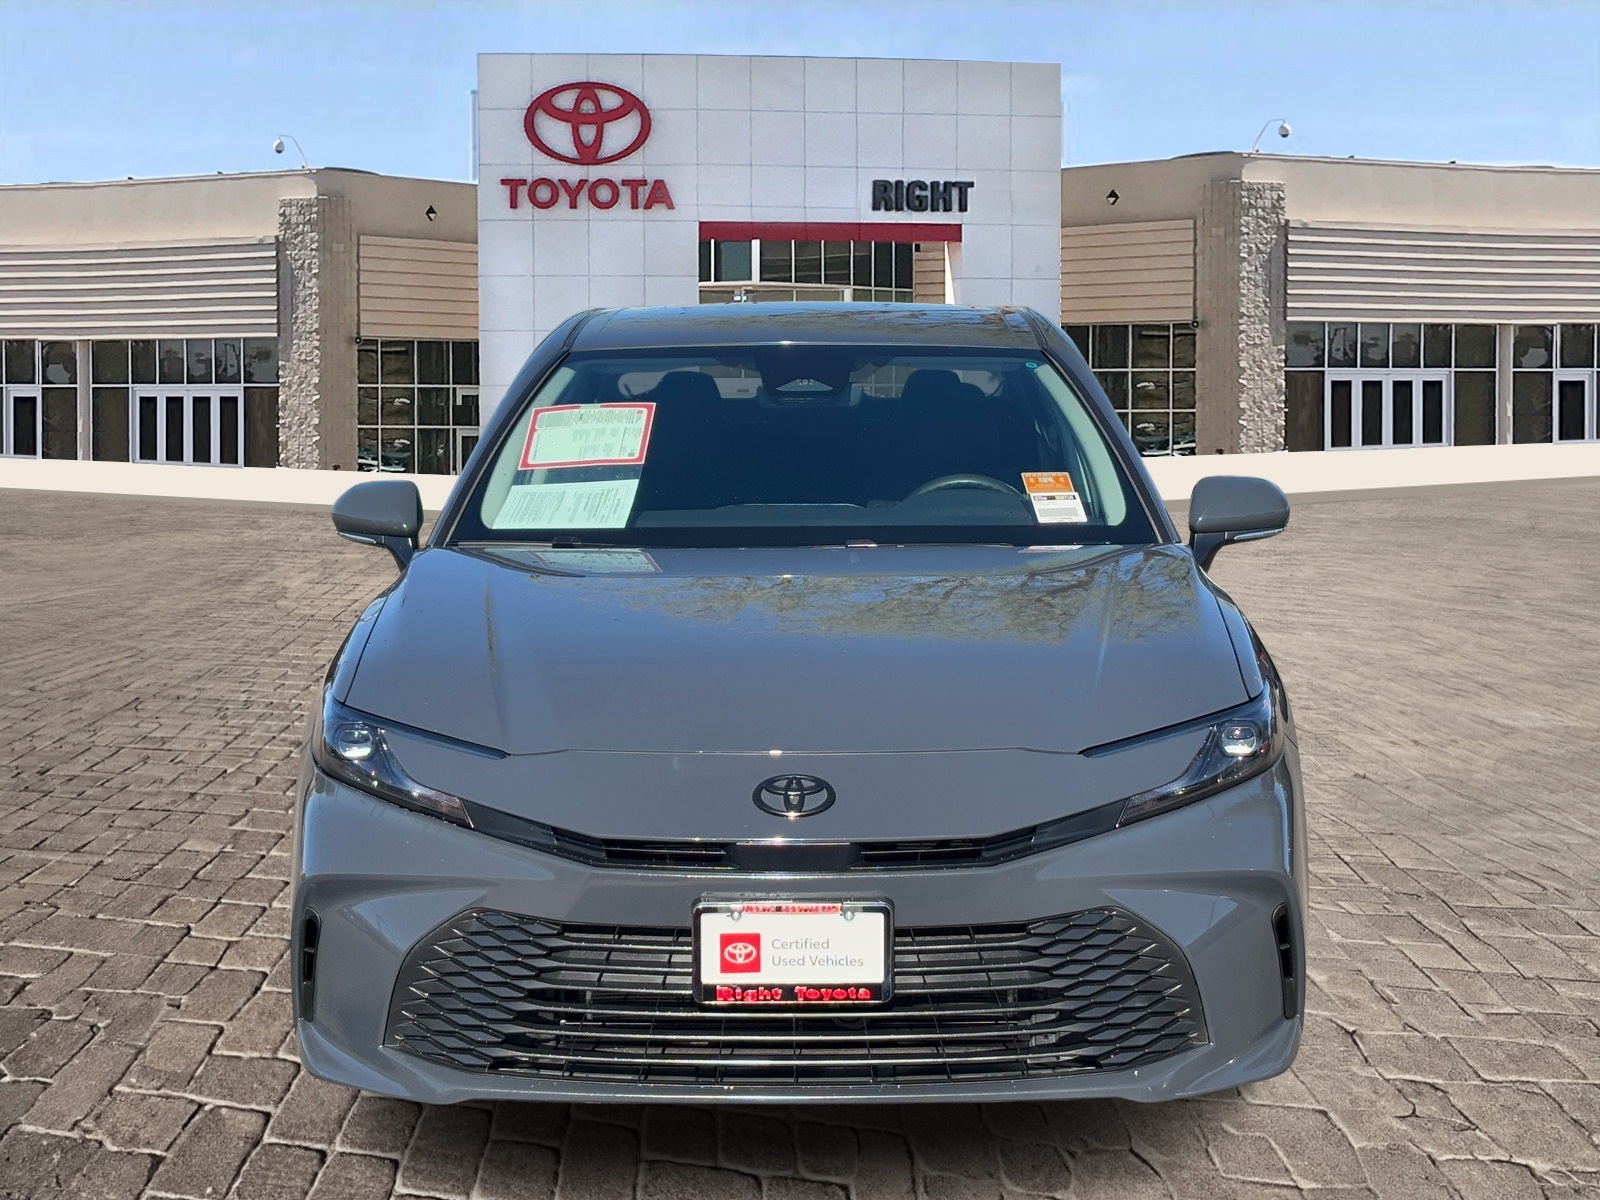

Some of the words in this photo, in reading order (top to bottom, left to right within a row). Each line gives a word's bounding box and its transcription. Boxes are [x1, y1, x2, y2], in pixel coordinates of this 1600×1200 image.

[500, 177, 675, 210] TOYOTA
[872, 179, 975, 212] RIGHT
[771, 938, 830, 950] Certified
[772, 955, 805, 967] Used
[809, 955, 864, 967] Vehicles
[716, 985, 783, 1002] Right
[795, 985, 872, 1001] Toyota
